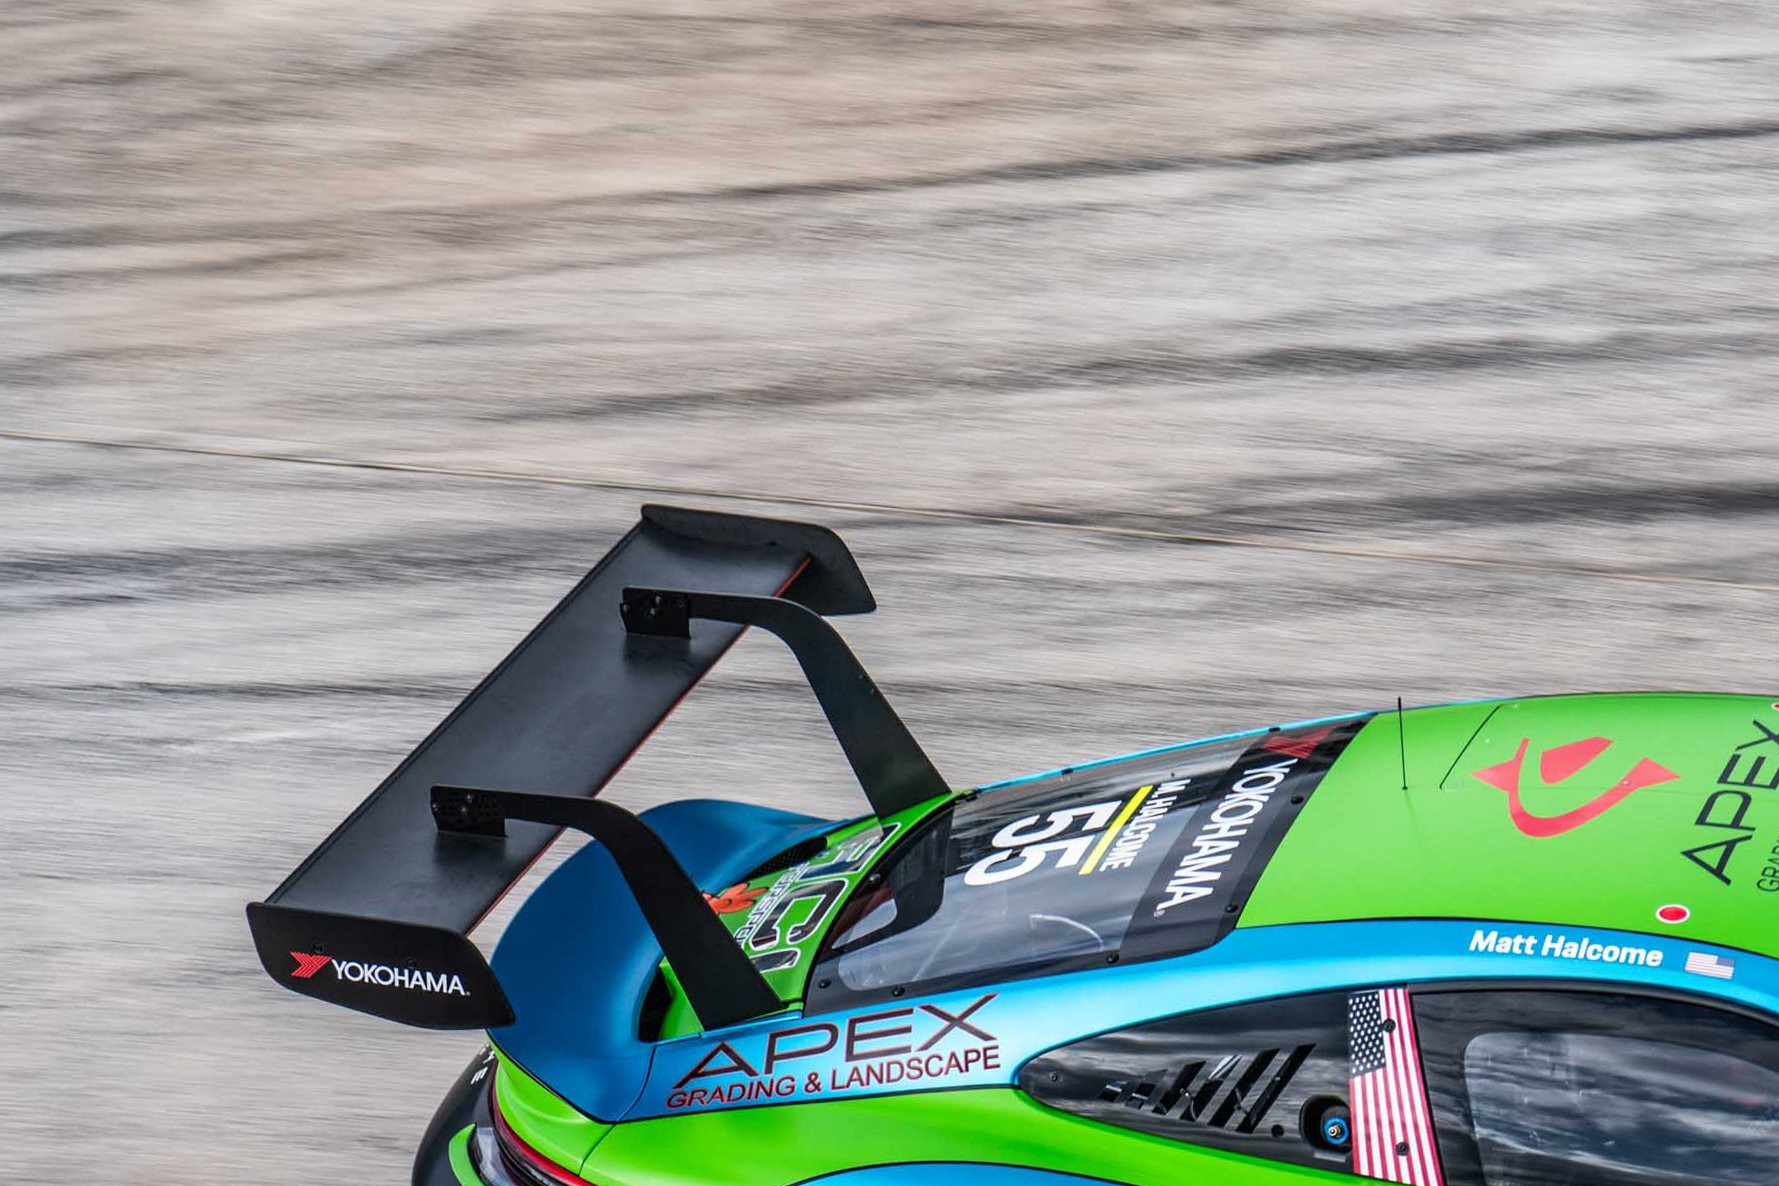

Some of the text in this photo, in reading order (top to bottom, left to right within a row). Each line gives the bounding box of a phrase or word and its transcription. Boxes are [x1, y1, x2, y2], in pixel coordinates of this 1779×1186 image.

[963, 799, 1122, 886] 55
[1099, 796, 1178, 872] HALCOME
[1155, 758, 1299, 911] YOKOHAMA
[331, 958, 467, 996] YOKOHAMA
[1469, 929, 1664, 967] Matt Halcome
[666, 1045, 1001, 1108] GRADING & LANDSCAPE
[672, 993, 998, 1089] APEX
